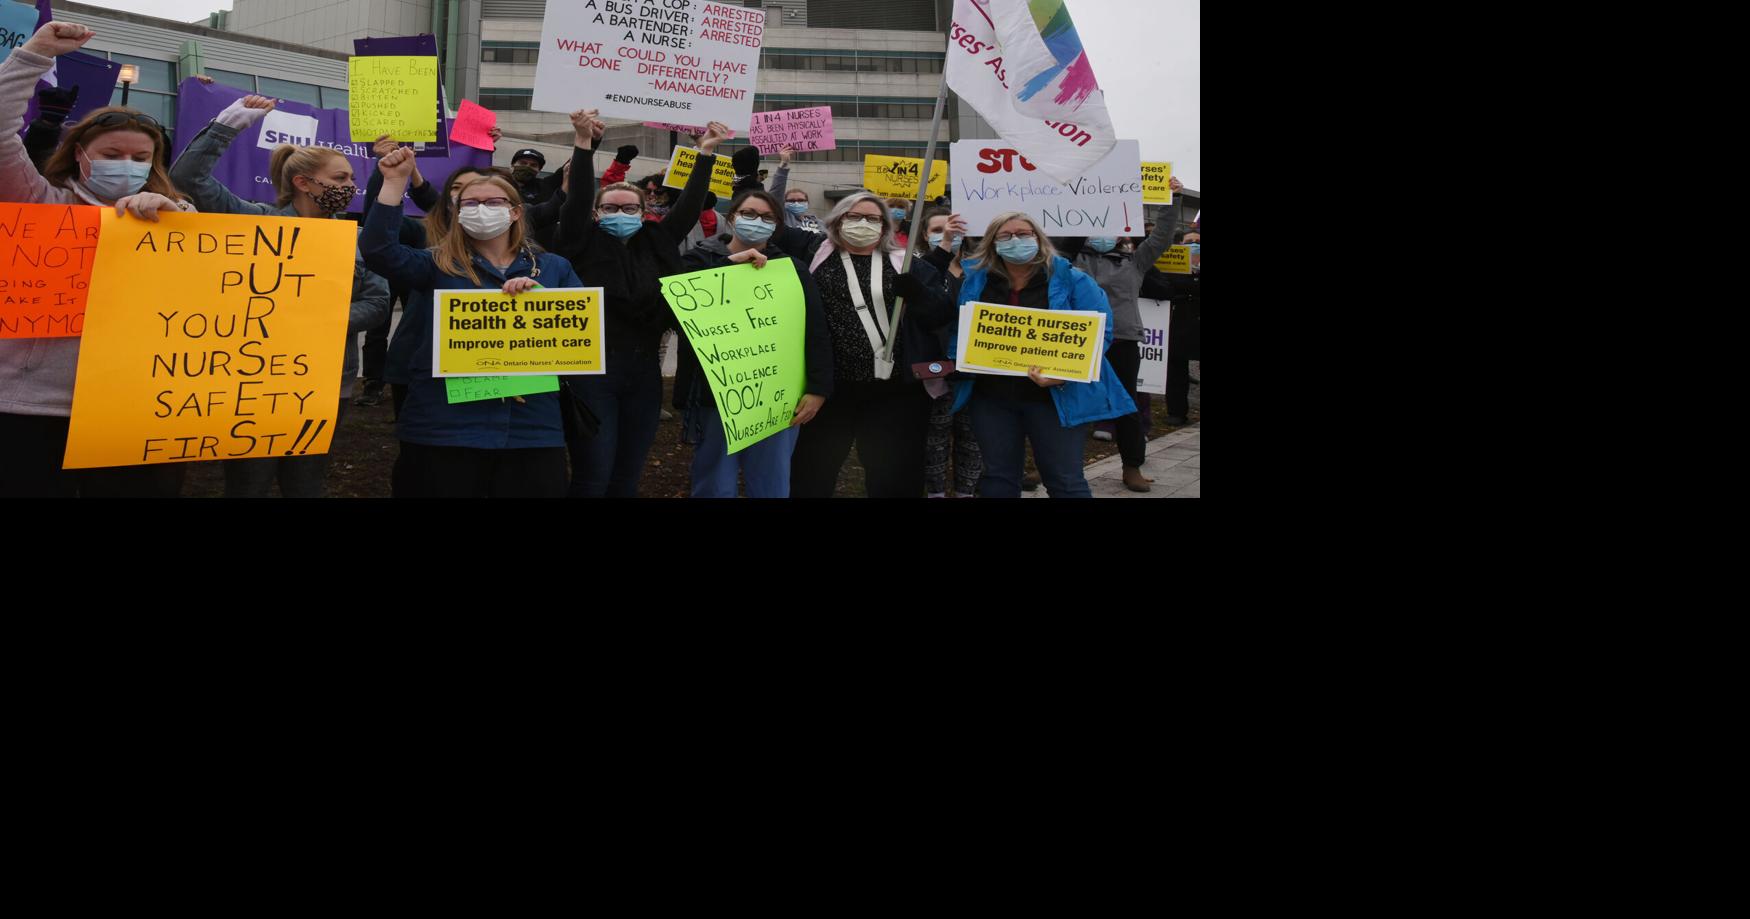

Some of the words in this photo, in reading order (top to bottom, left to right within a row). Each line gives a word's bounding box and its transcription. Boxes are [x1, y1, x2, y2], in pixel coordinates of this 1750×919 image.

[585, 0, 597, 10] A
[605, 2, 633, 15] BUS
[701, 17, 763, 36] ARRESTED
[703, 4, 764, 24] ARRESTED
[592, 13, 605, 24] A
[700, 29, 761, 48] ARRESTED
[623, 30, 635, 42] A
[557, 38, 603, 54] WHAT
[618, 46, 666, 62] COULD
[674, 54, 701, 67] YOU
[712, 60, 747, 75] HAVE
[350, 60, 363, 76] I
[579, 55, 622, 71] DONE
[637, 62, 729, 84] DIFFERENTLY?
[360, 87, 418, 95] SCRATCHED
[648, 79, 747, 100] -MANAGEMENT
[605, 93, 692, 110] #ENDNURSEABUSE
[363, 119, 405, 127] SCARED
[750, 126, 763, 134] HAS
[767, 124, 784, 133] BEEN
[788, 120, 826, 131] PHYSICALLY
[754, 115, 760, 124] 1
[764, 113, 773, 123] IN
[774, 113, 781, 122] 4
[787, 109, 821, 120] NURSES
[751, 133, 787, 144] ASSAULTED
[790, 131, 798, 140] AT
[801, 130, 823, 140] WORK
[808, 141, 818, 150] OK
[885, 174, 919, 184] NURSES
[898, 167, 907, 175] IN
[909, 163, 919, 175] 4
[961, 178, 1063, 201] Workplace
[1068, 176, 1142, 196] Violence
[1042, 205, 1110, 229] NOW
[136, 225, 301, 260] ARDEN!
[12, 244, 97, 270] NOT
[221, 262, 315, 297] PUT
[669, 272, 731, 312] 85%
[753, 283, 777, 300] OF
[449, 298, 517, 313] Protect
[524, 297, 591, 312] nurses'
[158, 296, 275, 339] YOUR
[449, 315, 506, 330] health
[512, 315, 527, 329] &
[532, 314, 589, 331] safety
[979, 309, 1032, 326] Protect
[1037, 318, 1092, 332] nurses'
[449, 338, 504, 351] Improve
[509, 337, 557, 350] patient
[562, 337, 591, 347] care
[976, 322, 1022, 338] health
[1026, 328, 1037, 341] &
[1041, 331, 1087, 348] safety
[152, 341, 309, 378] NURSES
[974, 339, 1018, 353] Improve
[1020, 346, 1058, 357] patient
[1061, 351, 1085, 361] care
[154, 381, 314, 418] SAFETY
[719, 381, 763, 418] 100%
[774, 389, 785, 402] OF
[143, 420, 327, 461] FIRST!!
